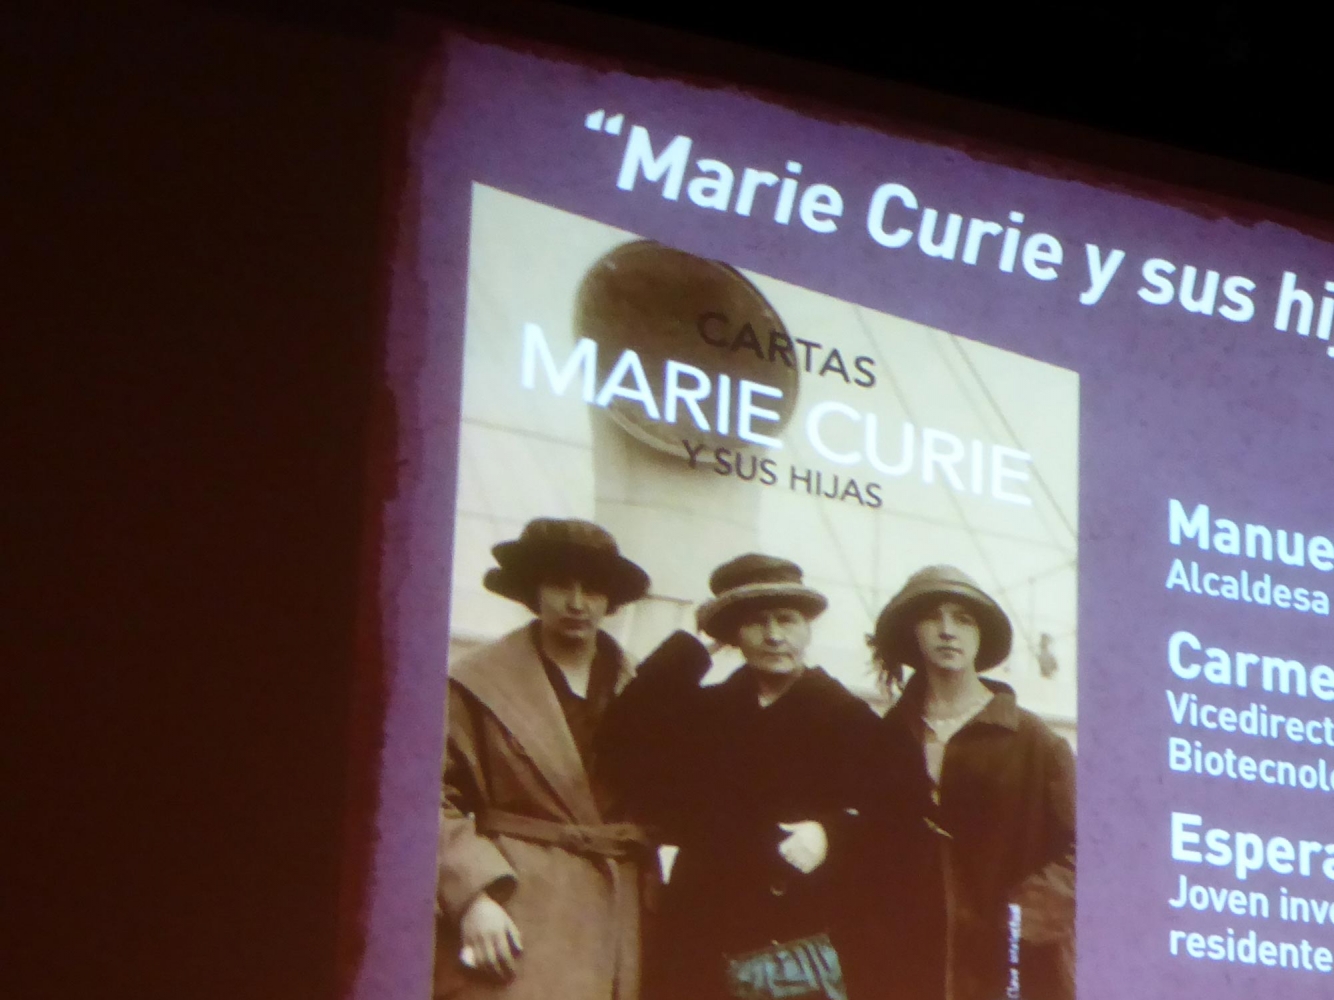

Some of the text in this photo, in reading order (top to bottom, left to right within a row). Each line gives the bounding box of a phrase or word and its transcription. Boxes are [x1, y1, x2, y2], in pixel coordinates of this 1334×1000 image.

[866, 182, 1063, 282] Curie
[1079, 245, 1125, 306] y
[1137, 256, 1256, 323] sus
[698, 311, 877, 389] CARTAS
[518, 322, 1034, 507] MARIE CURIE
[682, 440, 884, 510] Y SUS HIJAS
[1165, 560, 1330, 615] Alcaldesa
[1168, 876, 1270, 921] Joven
[1169, 926, 1334, 974] residente
